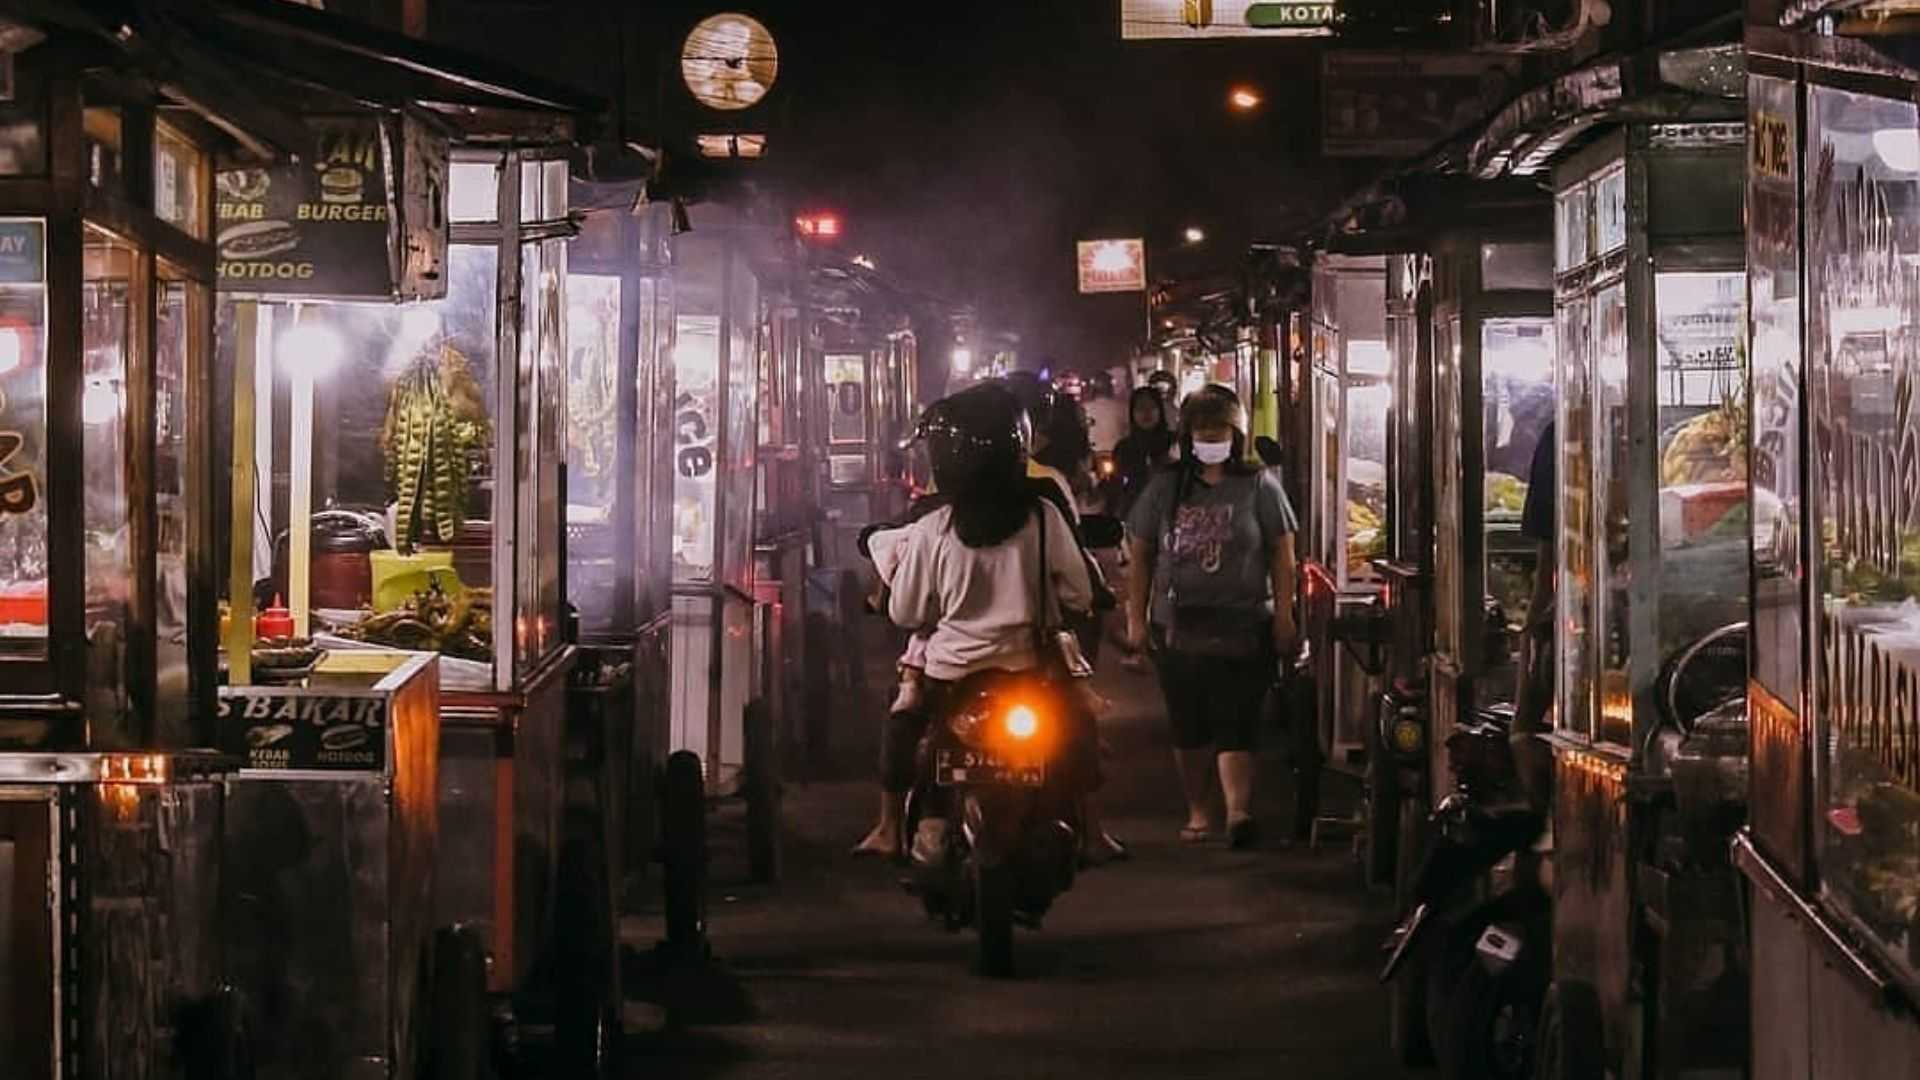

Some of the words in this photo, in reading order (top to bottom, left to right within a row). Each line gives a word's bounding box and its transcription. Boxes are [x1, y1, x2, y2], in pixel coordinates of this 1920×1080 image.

[217, 203, 264, 219] BAB
[297, 203, 387, 221] BURGER
[243, 696, 381, 727] BAKAR
